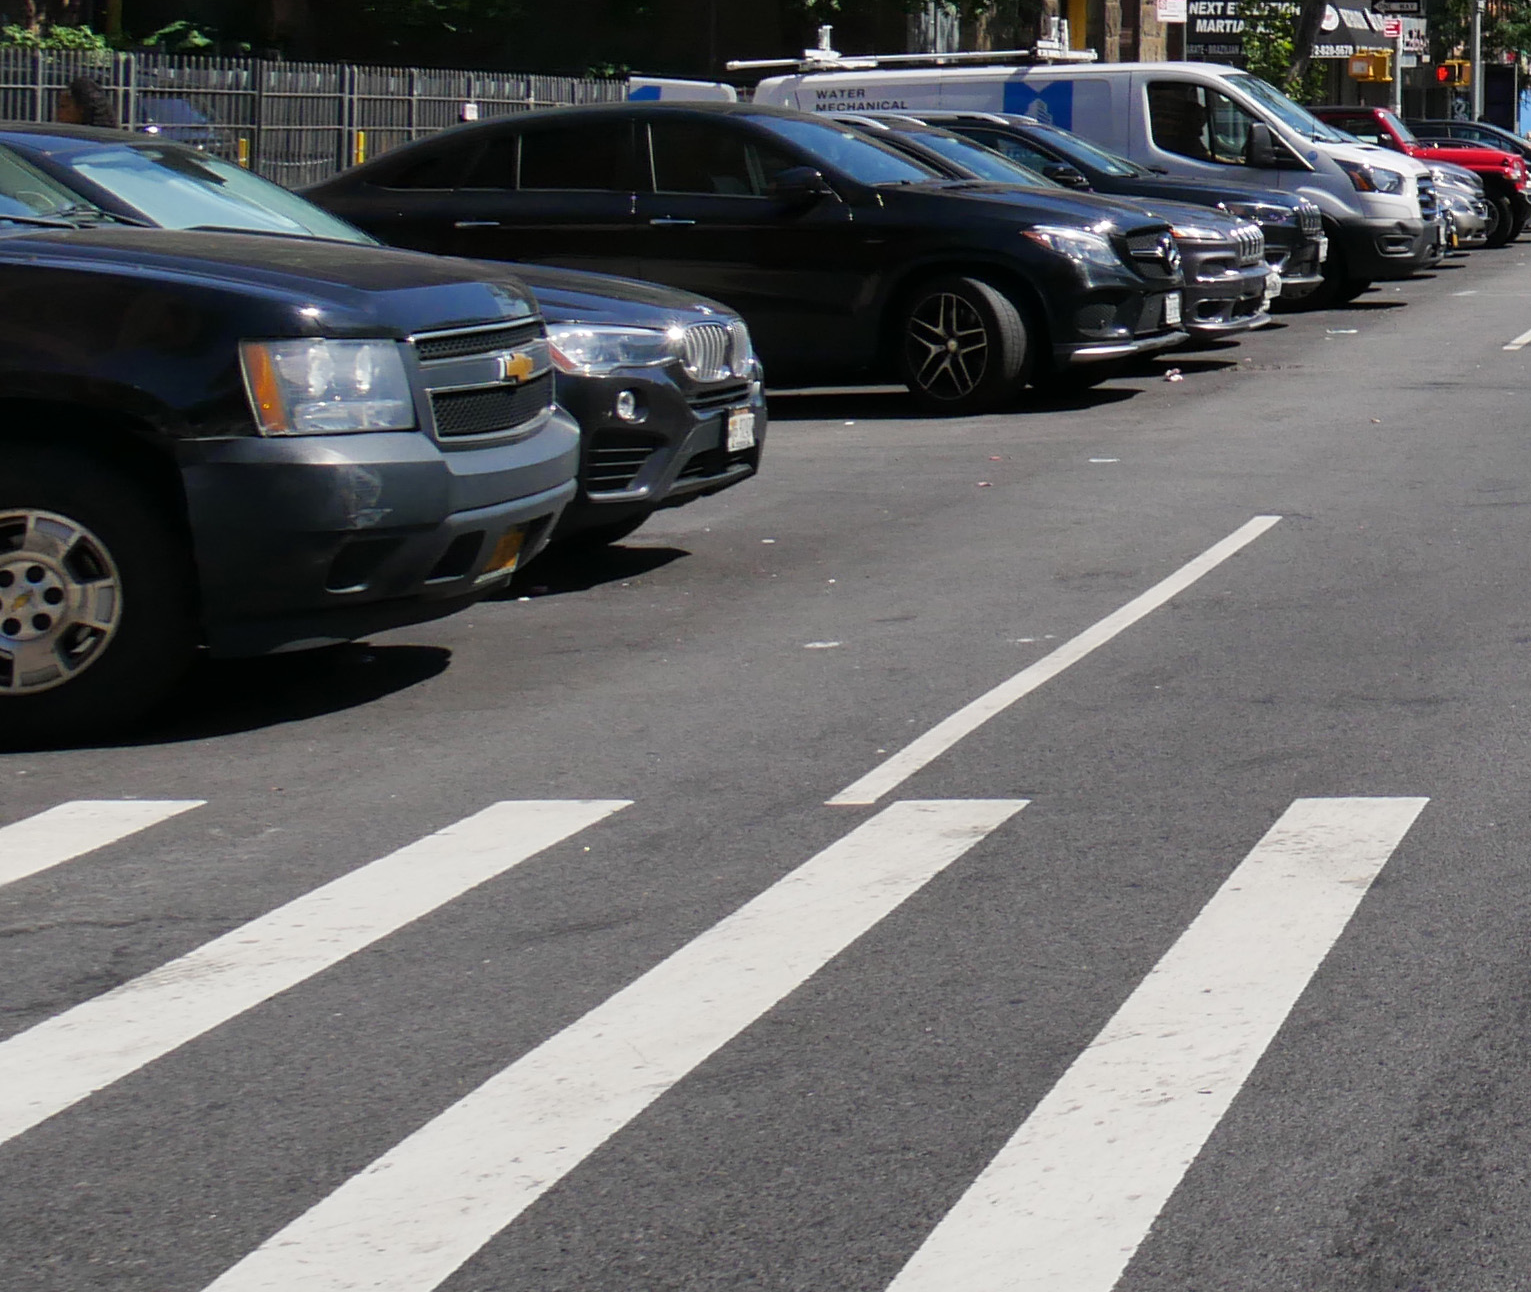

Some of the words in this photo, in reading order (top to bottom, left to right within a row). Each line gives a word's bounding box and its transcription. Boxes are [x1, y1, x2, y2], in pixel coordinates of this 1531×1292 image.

[1189, 1, 1224, 16] NEXT
[1195, 19, 1253, 34] MARTIA
[815, 88, 866, 100] WATER
[815, 100, 909, 112] MECHANICAL
